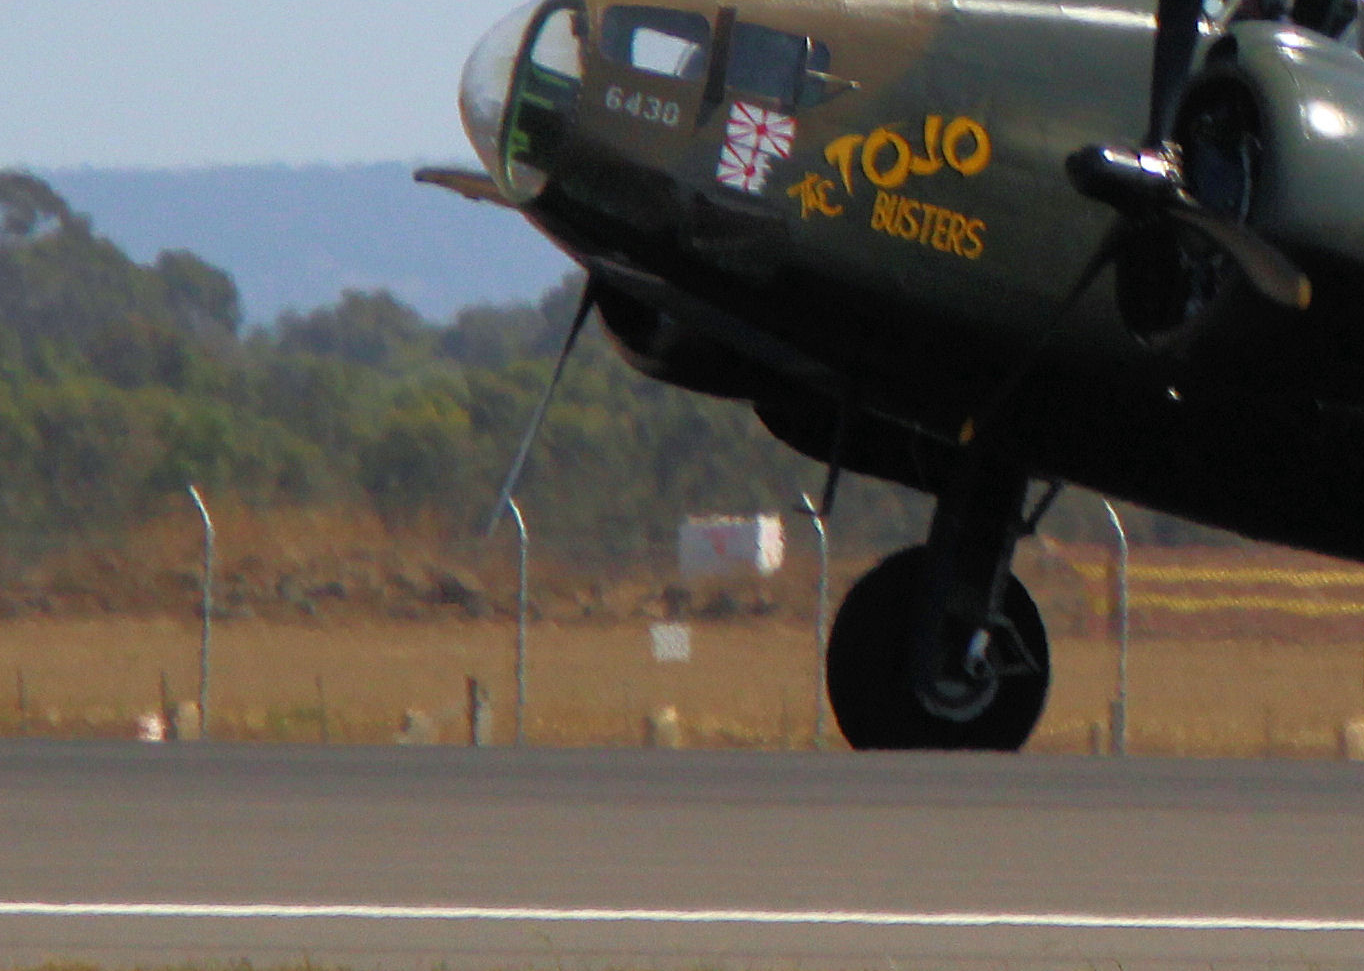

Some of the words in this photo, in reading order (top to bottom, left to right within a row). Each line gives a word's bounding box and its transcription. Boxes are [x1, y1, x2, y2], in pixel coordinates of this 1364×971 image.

[605, 85, 680, 126] 6430
[824, 114, 992, 197] TOJO
[871, 189, 987, 260] BUSTERS
